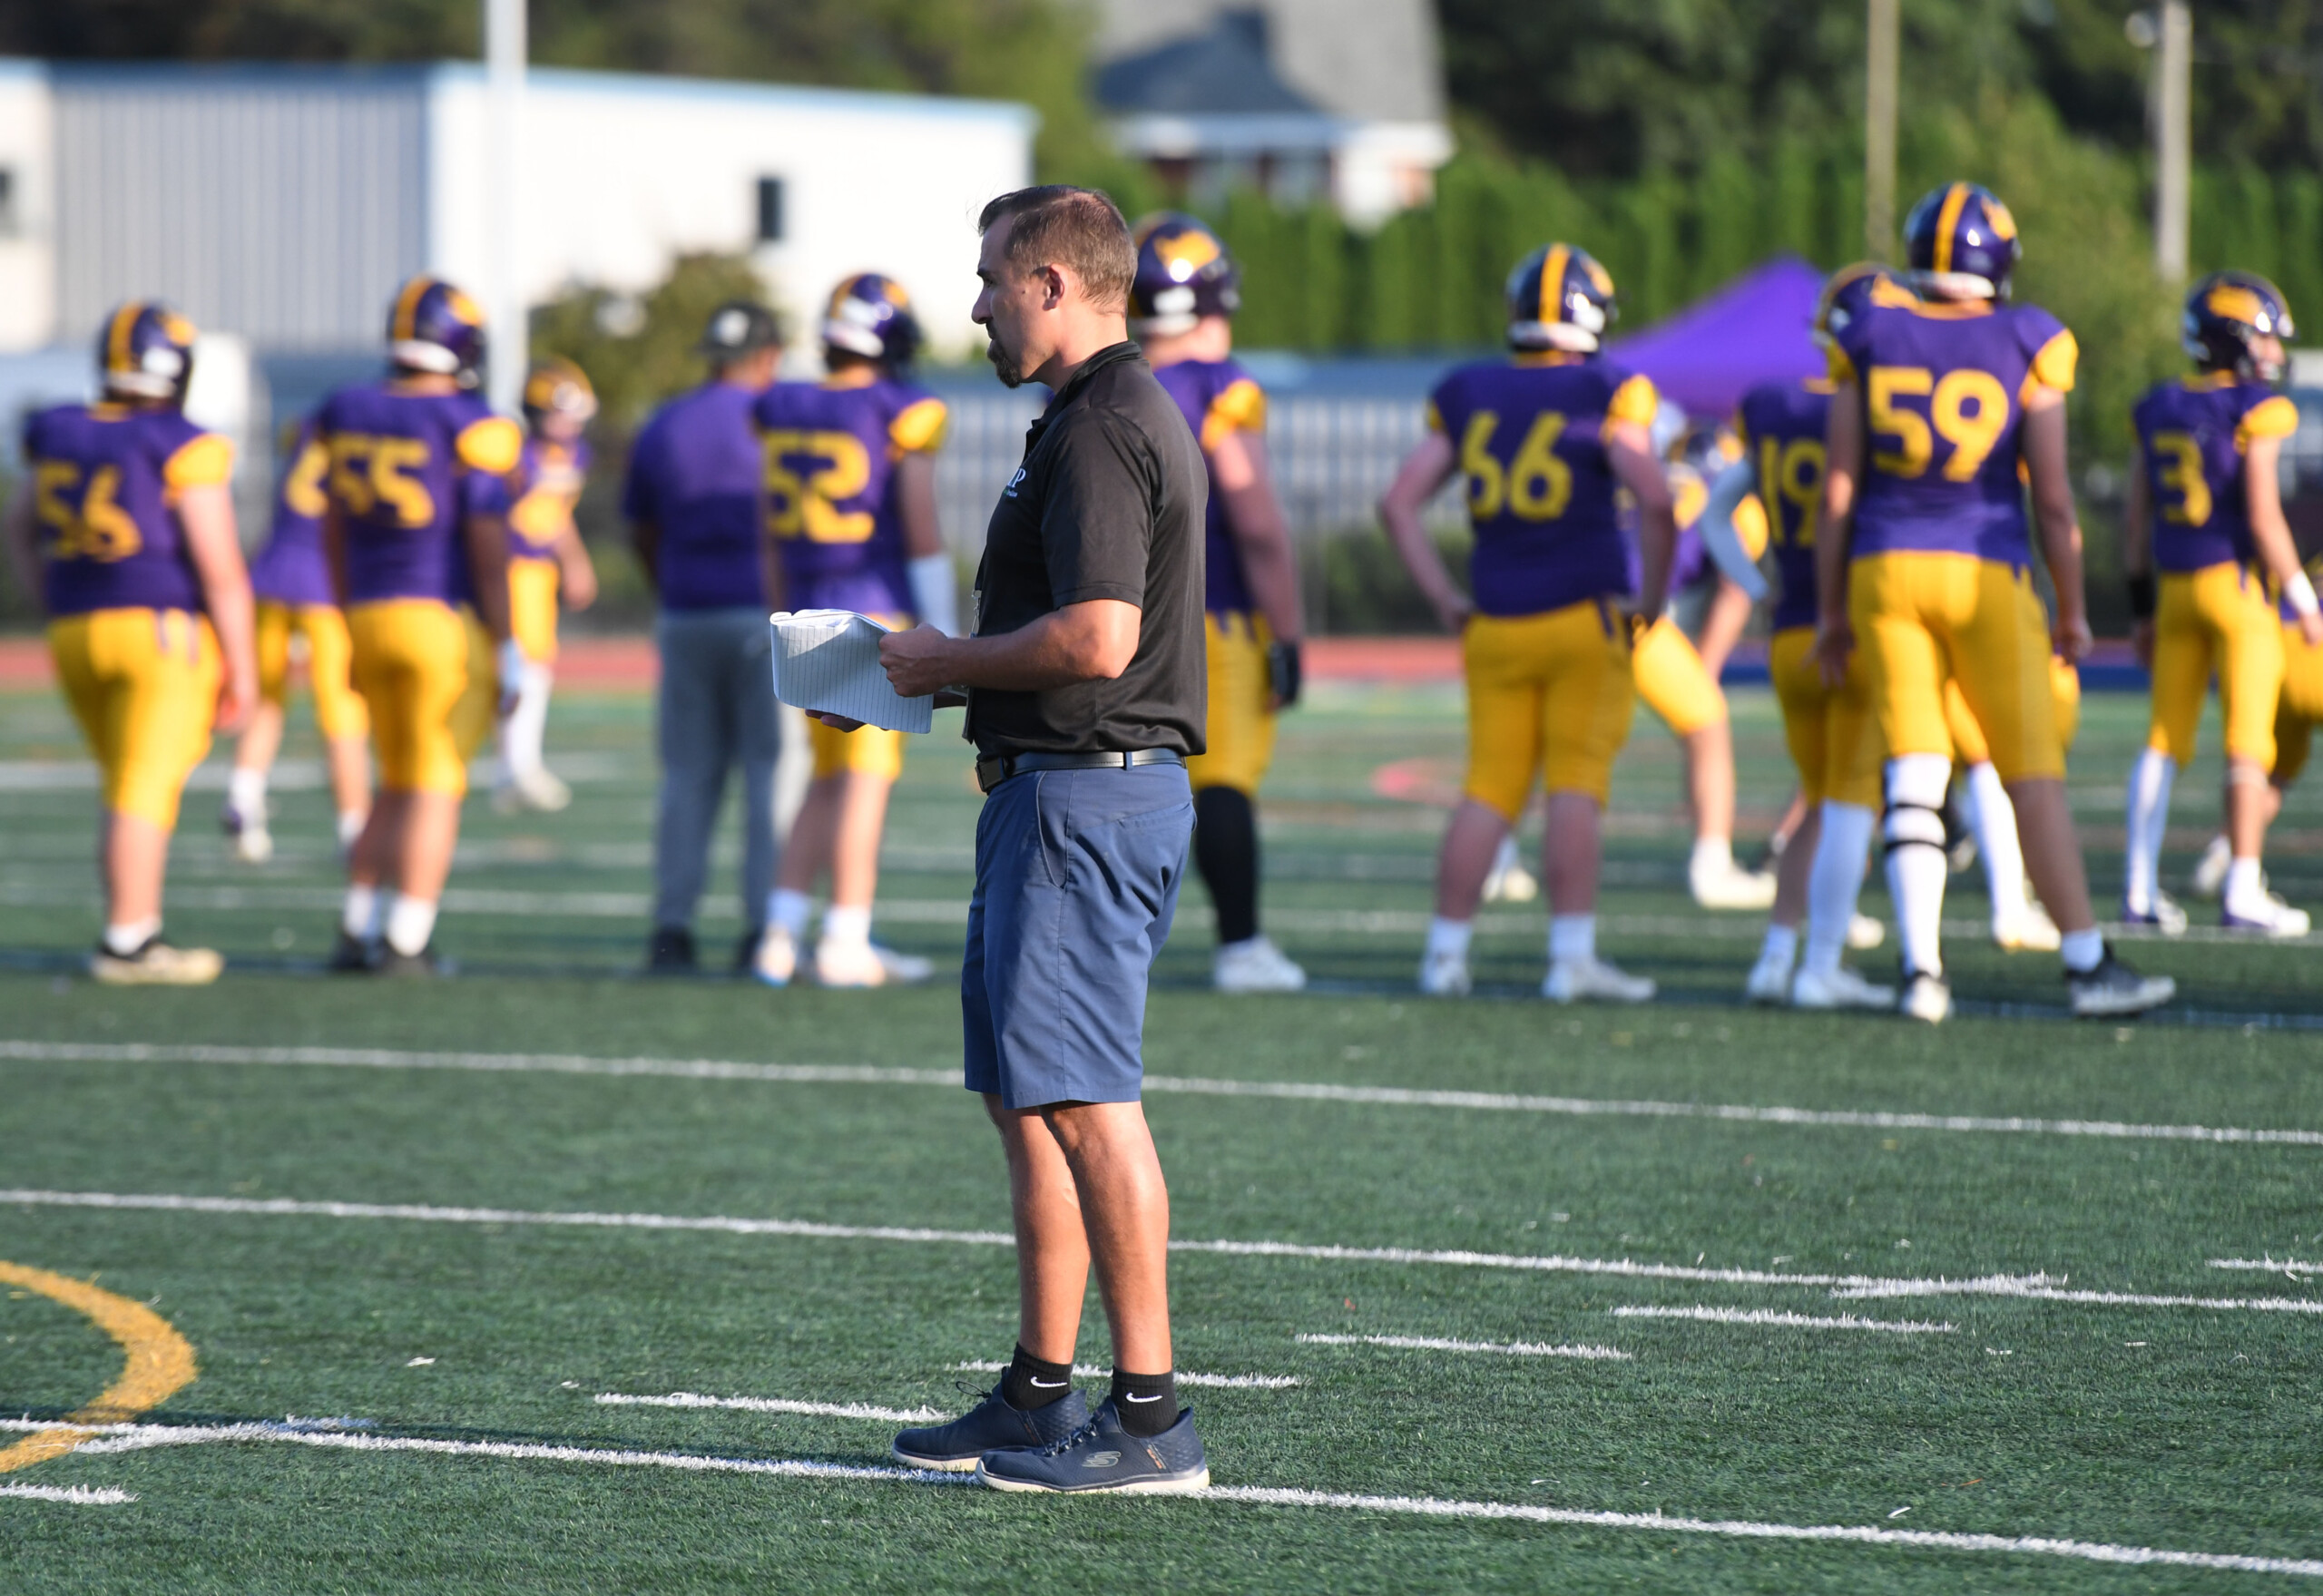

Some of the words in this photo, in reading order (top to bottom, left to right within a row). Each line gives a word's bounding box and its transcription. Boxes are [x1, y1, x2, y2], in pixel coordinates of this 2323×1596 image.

[1462, 411, 1573, 521] 66
[1868, 366, 2009, 483] 59
[34, 461, 142, 563] 56
[329, 433, 436, 528] 55
[763, 429, 874, 543] 52
[2153, 432, 2211, 528] 3
